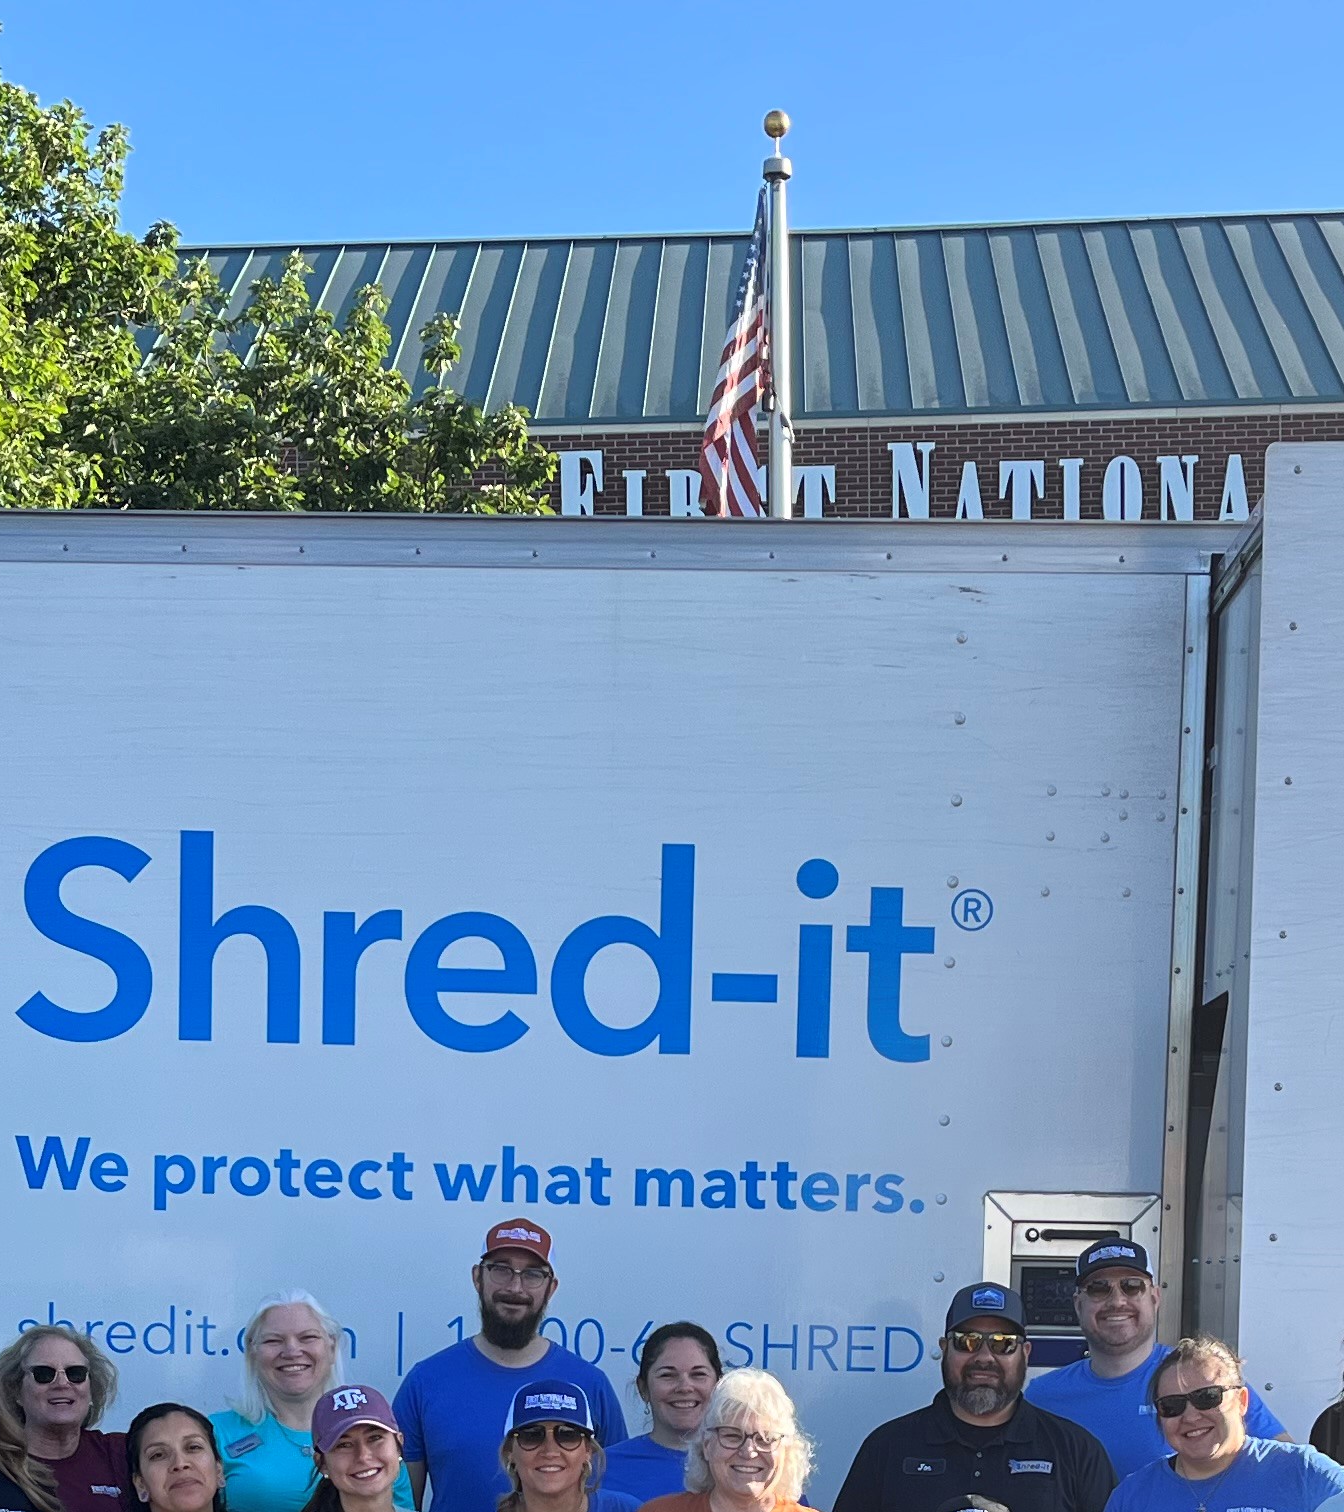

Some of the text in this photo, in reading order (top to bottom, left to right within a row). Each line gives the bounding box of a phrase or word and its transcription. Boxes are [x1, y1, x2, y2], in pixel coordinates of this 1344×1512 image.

[557, 442, 1250, 521] FIRT NATIONA
[15, 1135, 925, 1214] We protect what matters.
